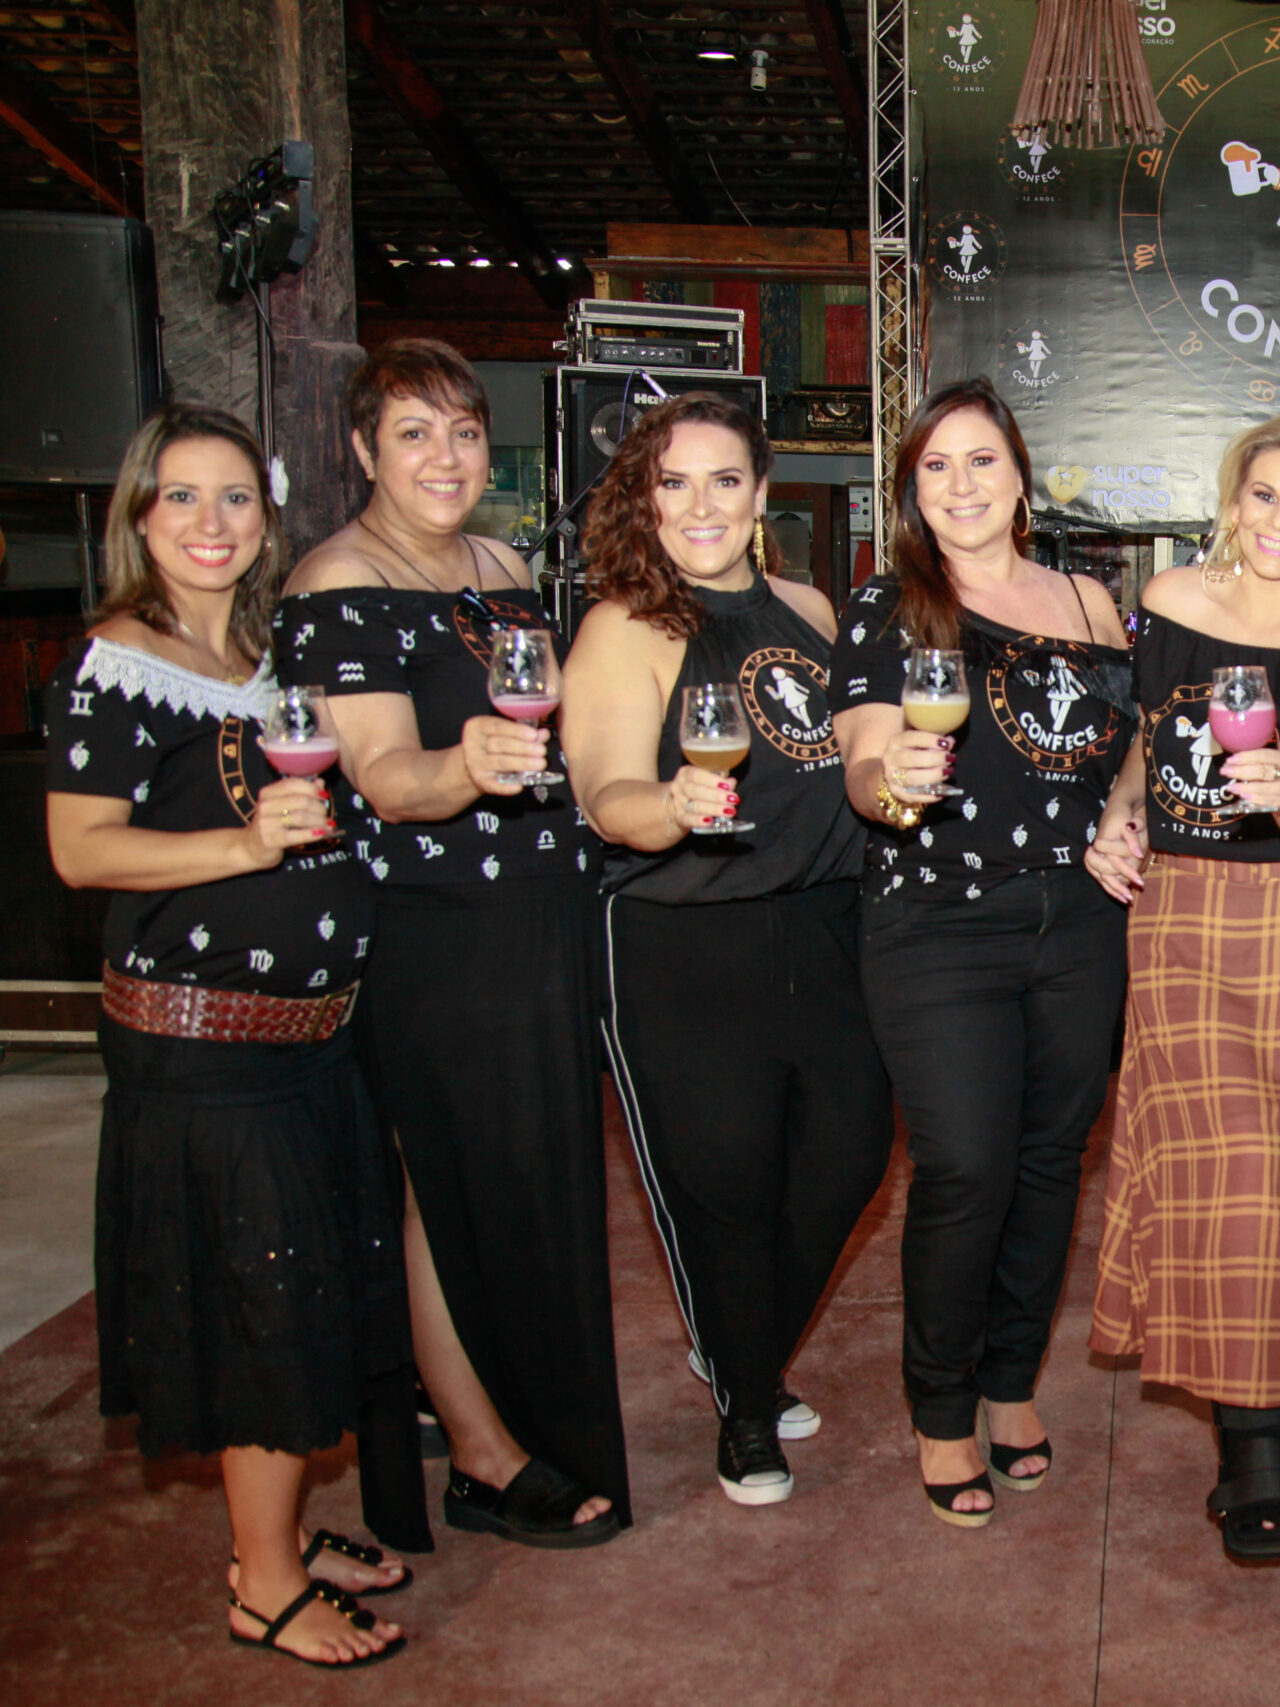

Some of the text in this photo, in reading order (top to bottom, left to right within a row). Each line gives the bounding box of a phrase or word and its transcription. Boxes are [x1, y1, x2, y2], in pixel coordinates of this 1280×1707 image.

[942, 54, 992, 75] CONFECE
[1012, 164, 1061, 184] CONFECE
[943, 265, 992, 284] CONFECE
[1012, 369, 1061, 388] CONFECE
[1093, 464, 1167, 489] super
[1092, 489, 1171, 508] nosso
[781, 720, 833, 742] CONFEC
[1019, 711, 1098, 752] CONFECE
[803, 762, 816, 772] 12
[1160, 764, 1237, 806] CONFEC
[1172, 823, 1231, 840] 12 ANOS
[298, 857, 316, 871] 12
